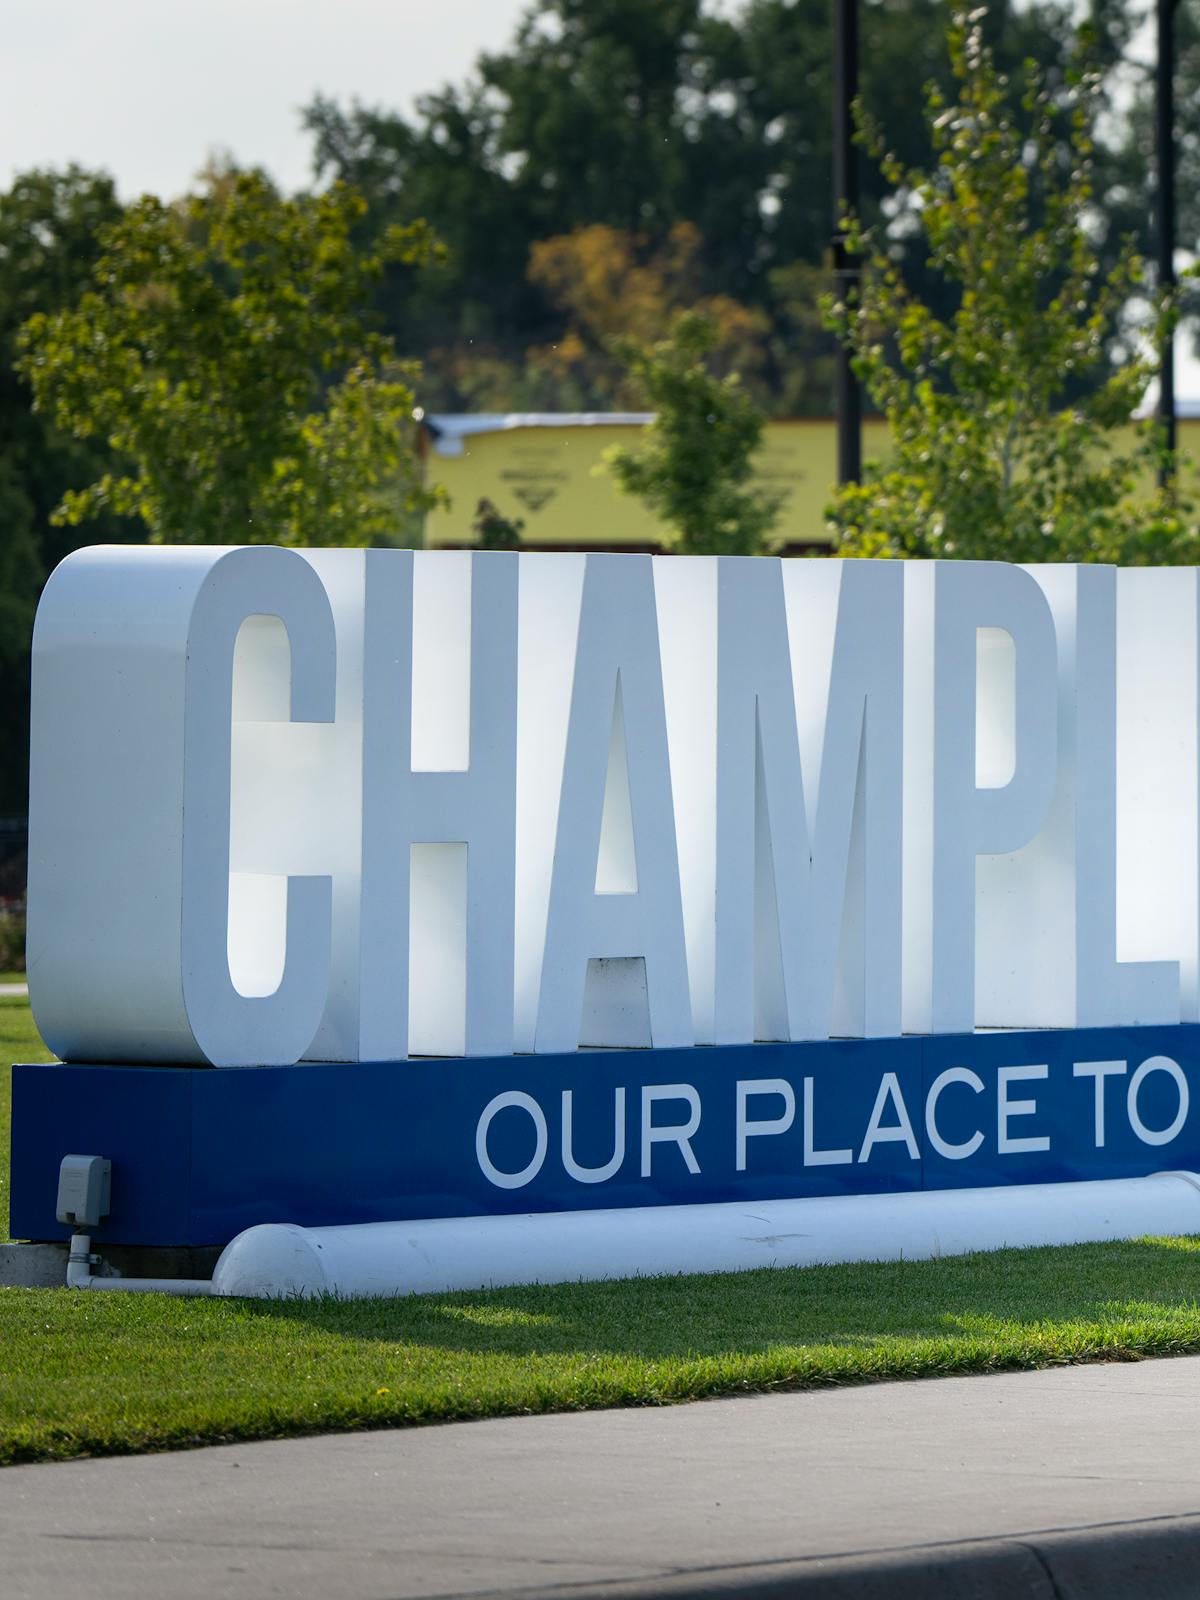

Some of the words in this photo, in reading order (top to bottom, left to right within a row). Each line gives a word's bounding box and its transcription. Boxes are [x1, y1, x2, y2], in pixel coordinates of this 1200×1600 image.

[475, 1083, 701, 1189] OUR
[736, 1064, 1050, 1171] PLACE
[1073, 1055, 1189, 1147] TO
